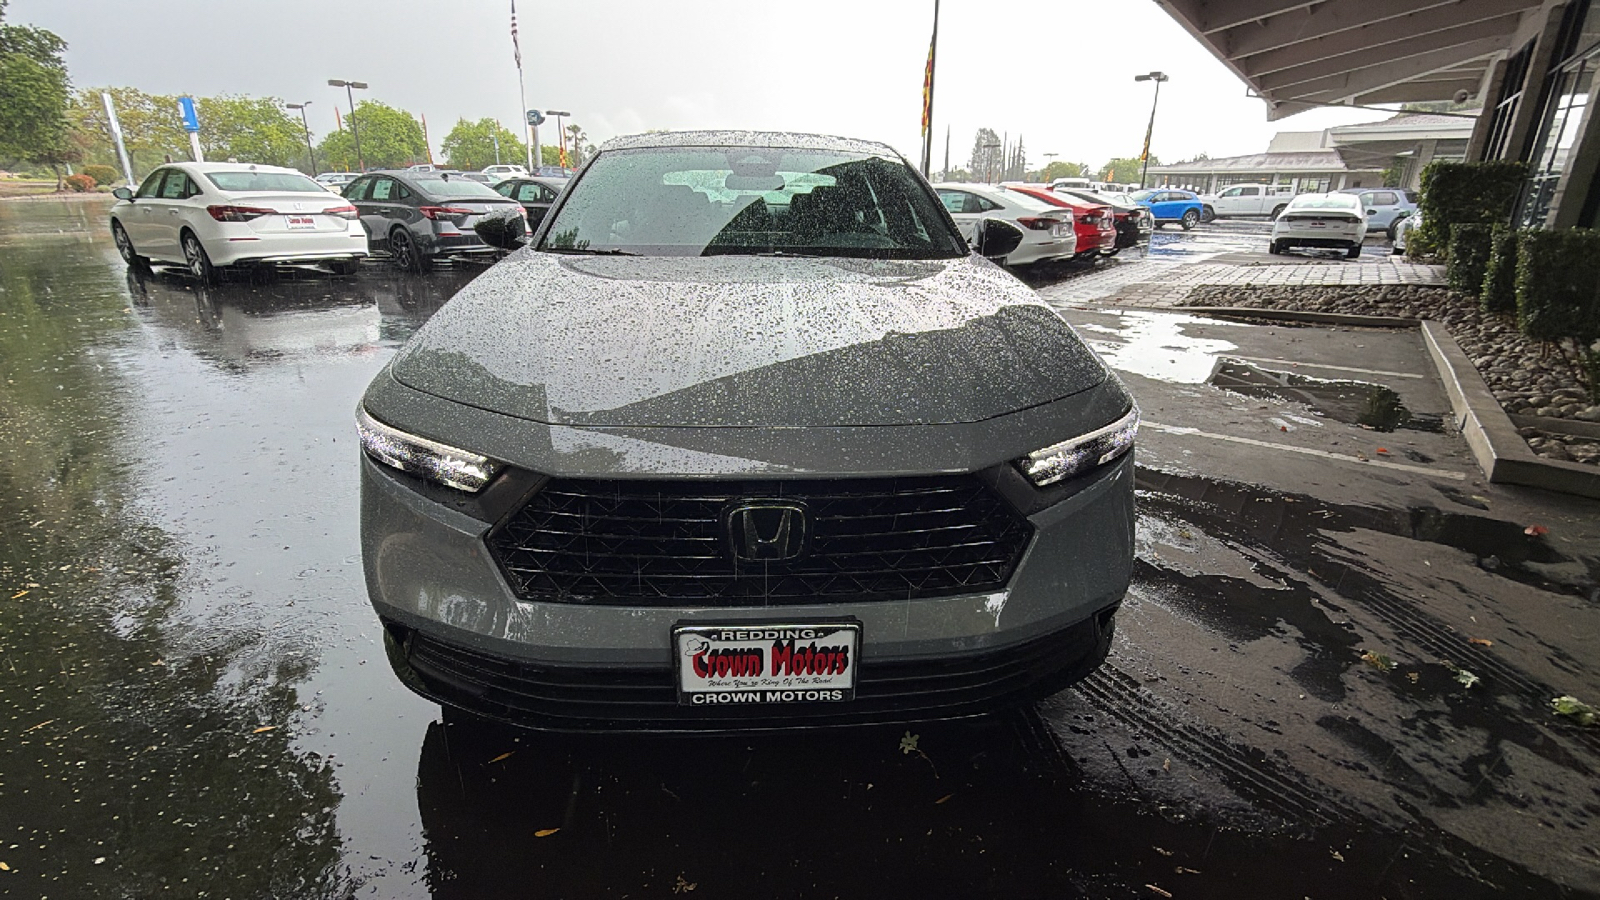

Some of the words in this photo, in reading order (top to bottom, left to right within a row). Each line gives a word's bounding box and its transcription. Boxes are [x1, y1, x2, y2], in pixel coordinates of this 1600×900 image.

[721, 629, 813, 641] REDDING
[692, 646, 764, 679] Crown
[771, 641, 849, 678] Motors
[761, 678, 780, 687] King
[783, 677, 793, 686] Of
[692, 692, 761, 704] CROWN
[766, 690, 843, 702] MOTORS
